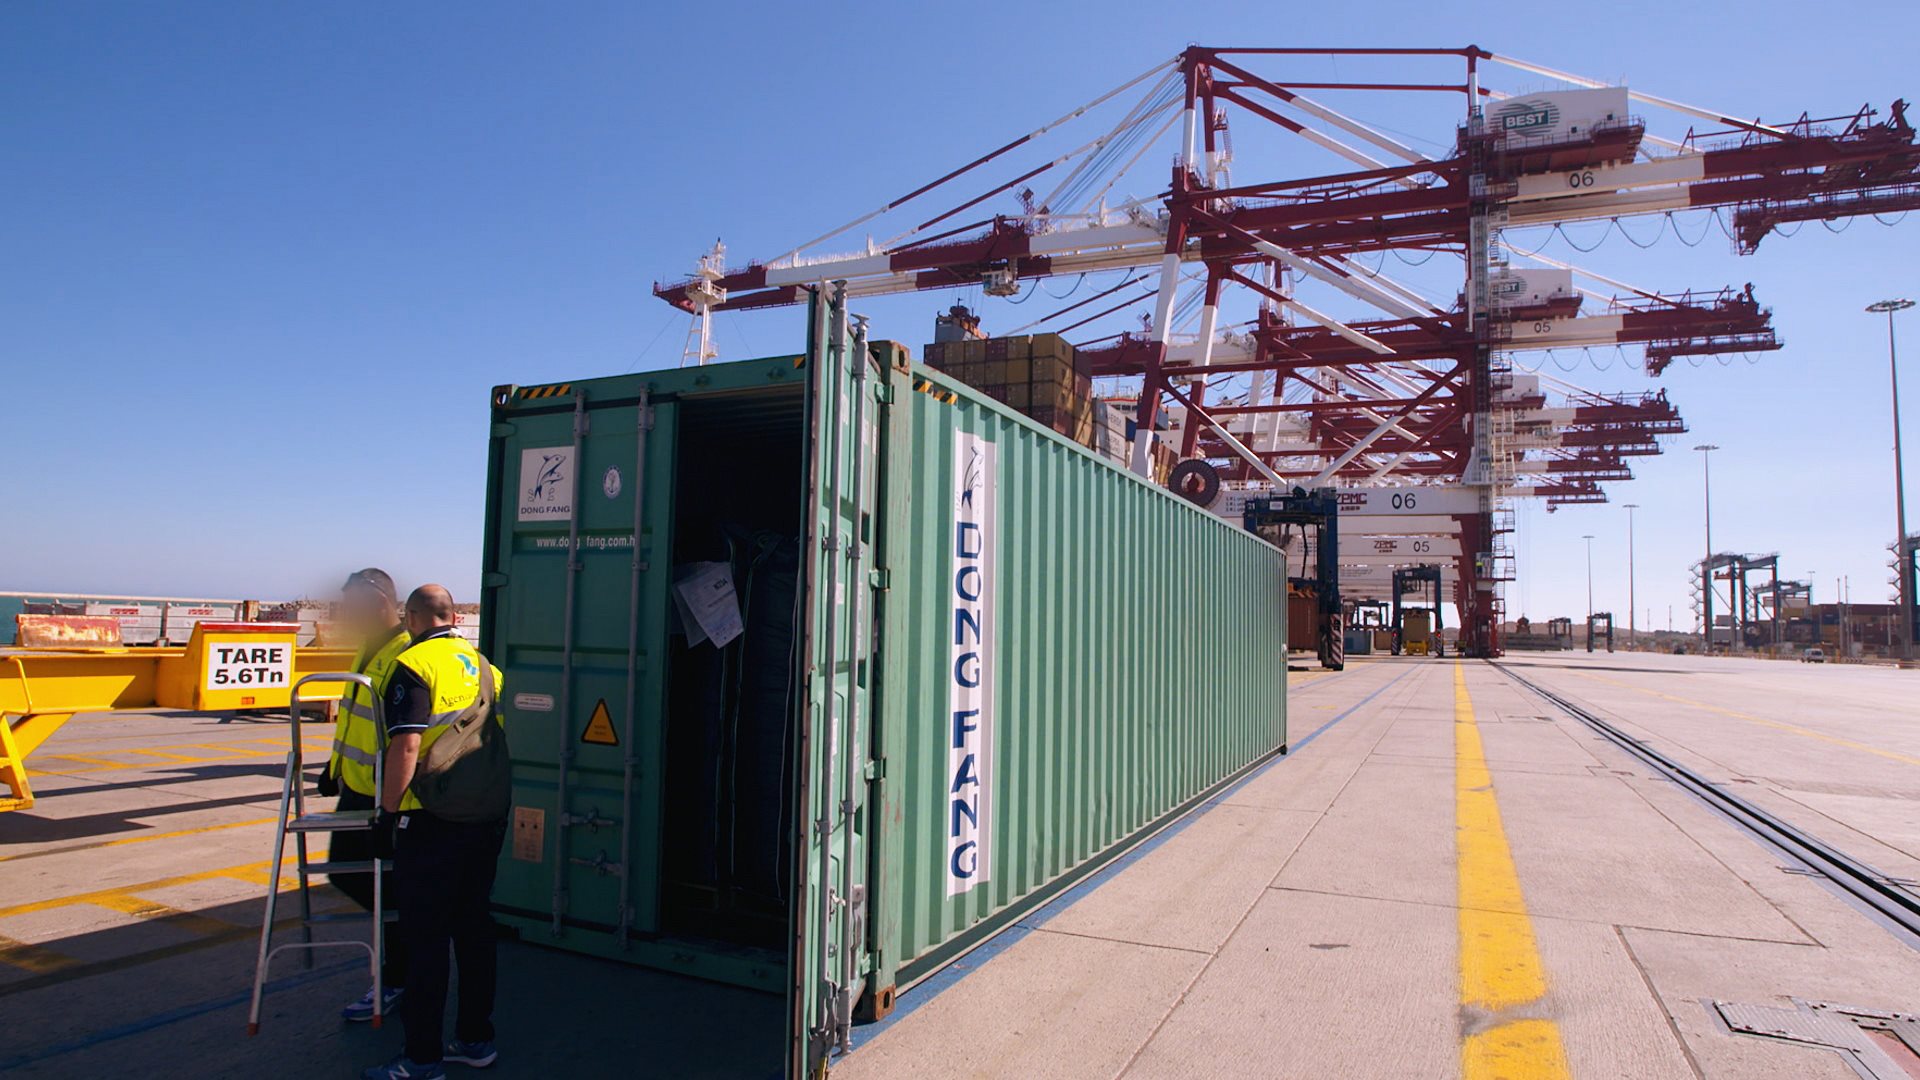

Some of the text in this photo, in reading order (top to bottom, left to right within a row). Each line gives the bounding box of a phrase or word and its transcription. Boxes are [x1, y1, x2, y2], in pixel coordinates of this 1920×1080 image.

[1506, 112, 1545, 128] BEST
[1569, 171, 1594, 188] 06
[1534, 321, 1551, 334] 05
[1391, 492, 1417, 510] 06
[536, 535, 636, 550] www.dog fang.com.h
[1374, 540, 1398, 549] ZPMC
[1413, 541, 1430, 553] 05
[217, 648, 283, 664] TARE
[214, 668, 283, 685] 5.6Tn
[950, 521, 982, 879] DONG FANG
